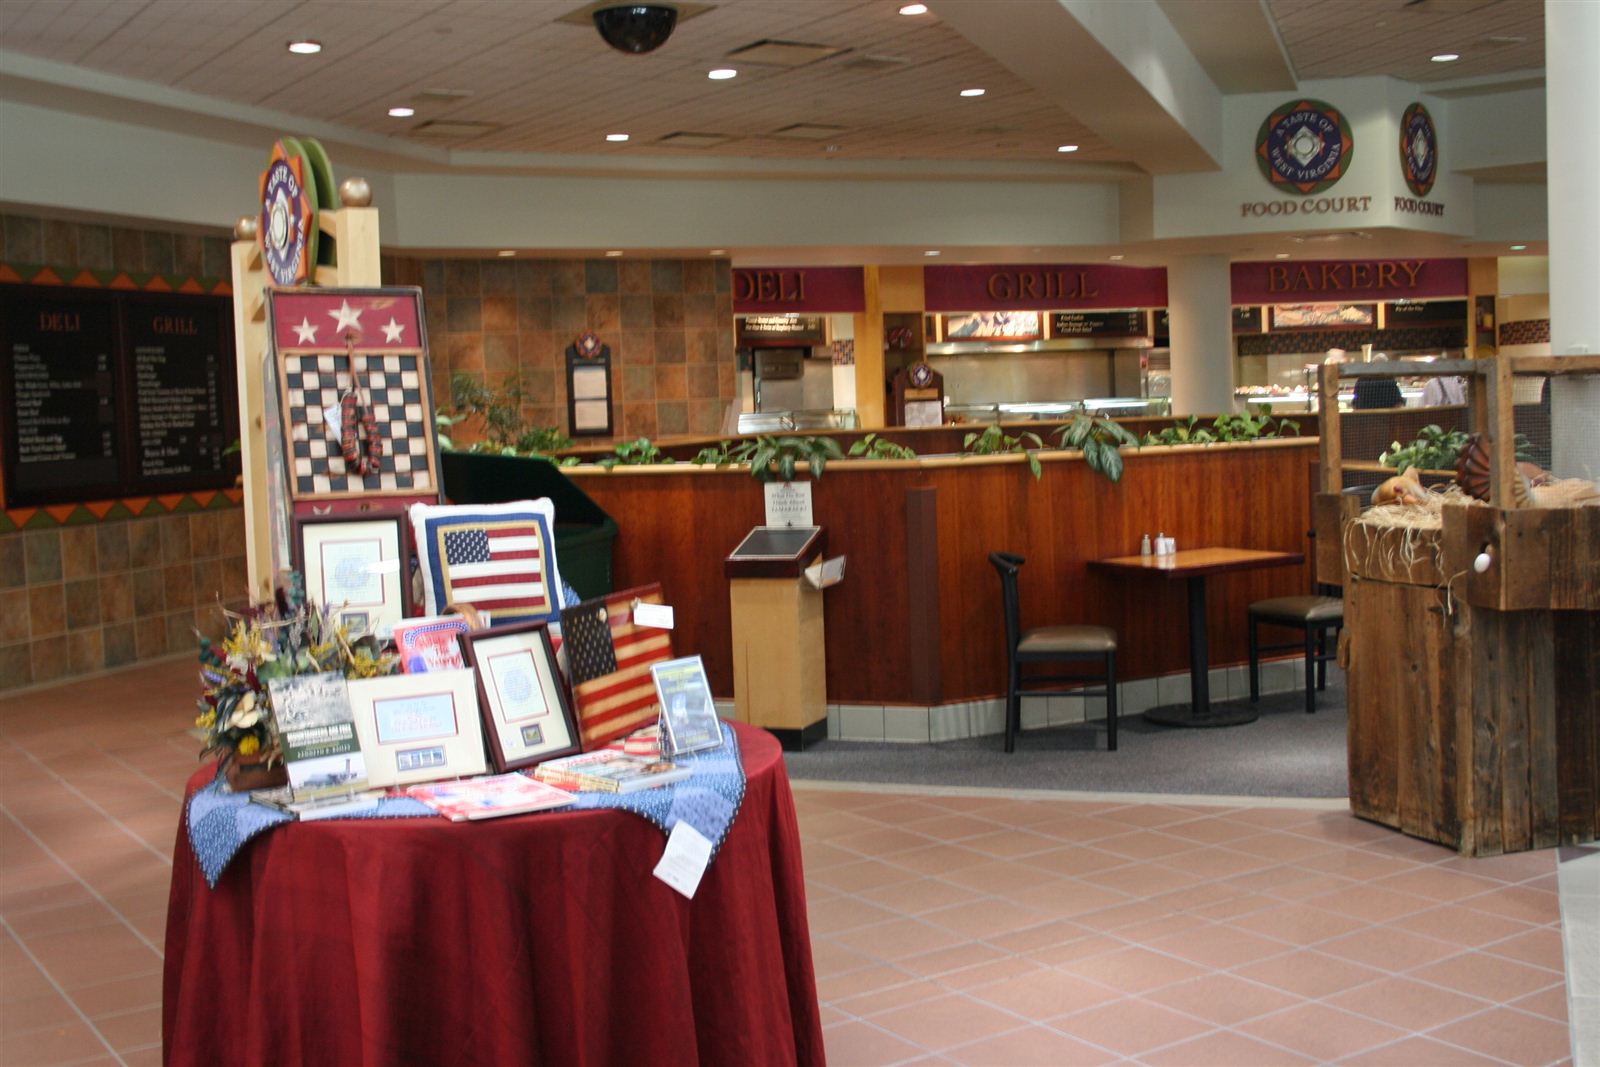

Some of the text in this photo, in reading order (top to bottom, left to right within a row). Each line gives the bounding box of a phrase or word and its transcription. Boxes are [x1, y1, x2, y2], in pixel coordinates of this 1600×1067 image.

[1276, 111, 1335, 138] A TASTE OF
[1271, 143, 1341, 180] WEST VIRGINIA
[1241, 196, 1373, 217] FOOD COURT
[1394, 197, 1445, 216] FOOD COURT
[731, 271, 806, 302] DELI
[986, 271, 1099, 301] GRILL
[1268, 259, 1425, 292] BAKERY
[39, 312, 81, 332] DELI
[152, 316, 198, 335] GRILL
